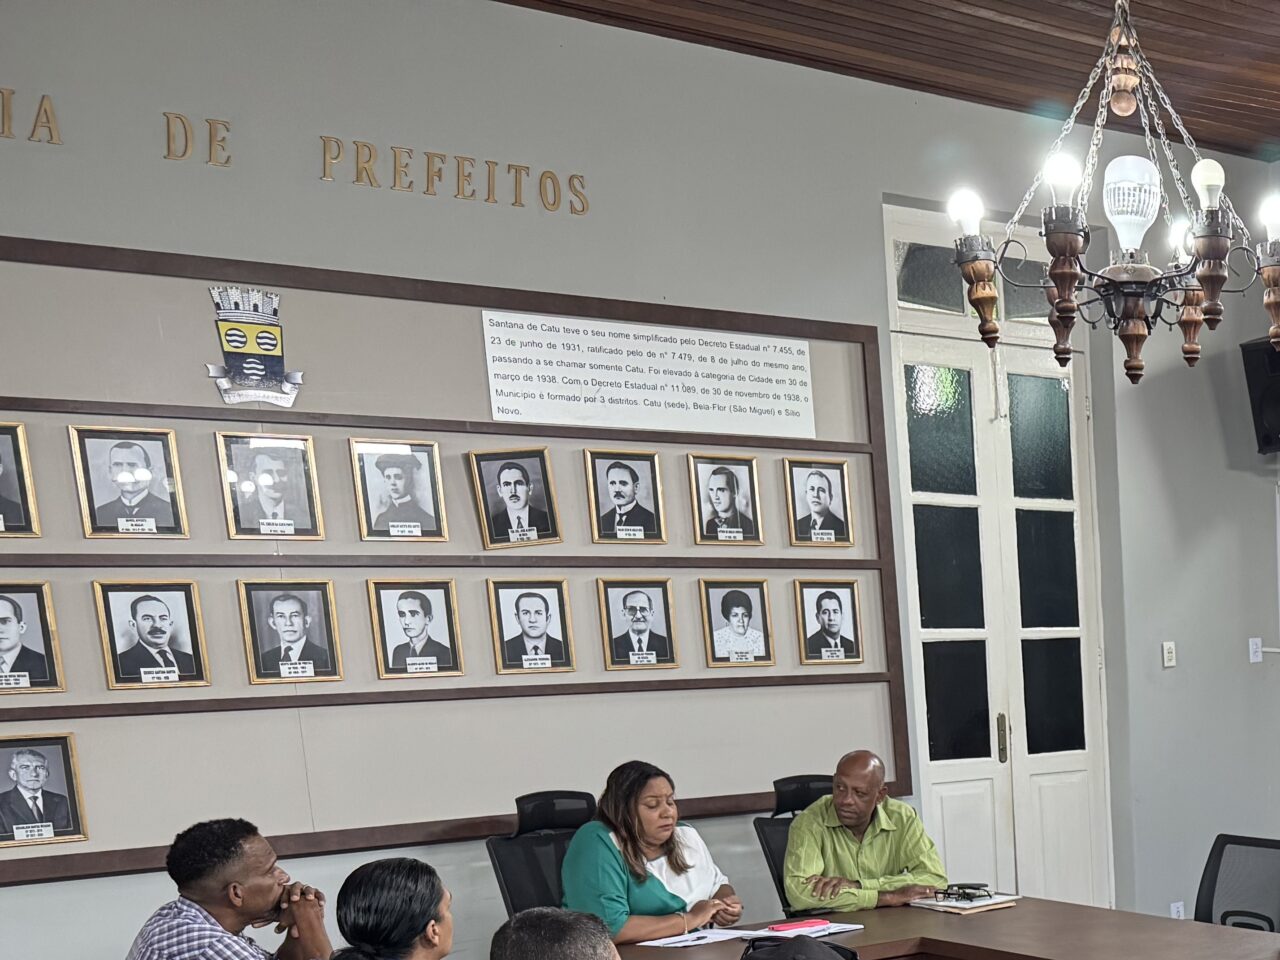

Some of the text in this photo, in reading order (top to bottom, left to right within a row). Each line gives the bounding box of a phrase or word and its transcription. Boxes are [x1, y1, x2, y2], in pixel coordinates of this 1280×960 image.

[164, 112, 232, 167] DE
[319, 136, 590, 216] PREFEITOS
[488, 319, 524, 330] Santana
[527, 322, 538, 331] de
[541, 324, 560, 333] Catu
[563, 326, 580, 335] teve
[633, 332, 677, 345] simplificado
[680, 337, 696, 347] pelo
[698, 339, 727, 348] Decreto
[730, 342, 760, 351] Estadual
[796, 348, 805, 356] de
[490, 337, 501, 345] 23
[505, 338, 516, 346] de
[520, 339, 543, 350] junho
[562, 343, 584, 353] 1931,
[587, 345, 623, 355] ratificado
[626, 348, 643, 358] pelo
[647, 350, 656, 358] de
[730, 358, 748, 367] julho
[764, 362, 789, 370] mesmo
[492, 354, 533, 366] passando
[556, 359, 586, 369] chamar
[589, 362, 623, 372] somente
[663, 368, 692, 377] elevado
[701, 372, 735, 382] categoria
[748, 375, 773, 384] Cidade
[494, 373, 520, 383] março
[523, 374, 533, 382] de
[562, 376, 581, 385] Com
[591, 379, 622, 388] Decreto
[625, 381, 658, 391] Estadual
[700, 387, 710, 395] de
[735, 390, 770, 399] novembro
[547, 392, 581, 402] formado
[584, 395, 597, 404] por
[643, 399, 661, 407] Catu
[749, 406, 775, 416] Miguel)
